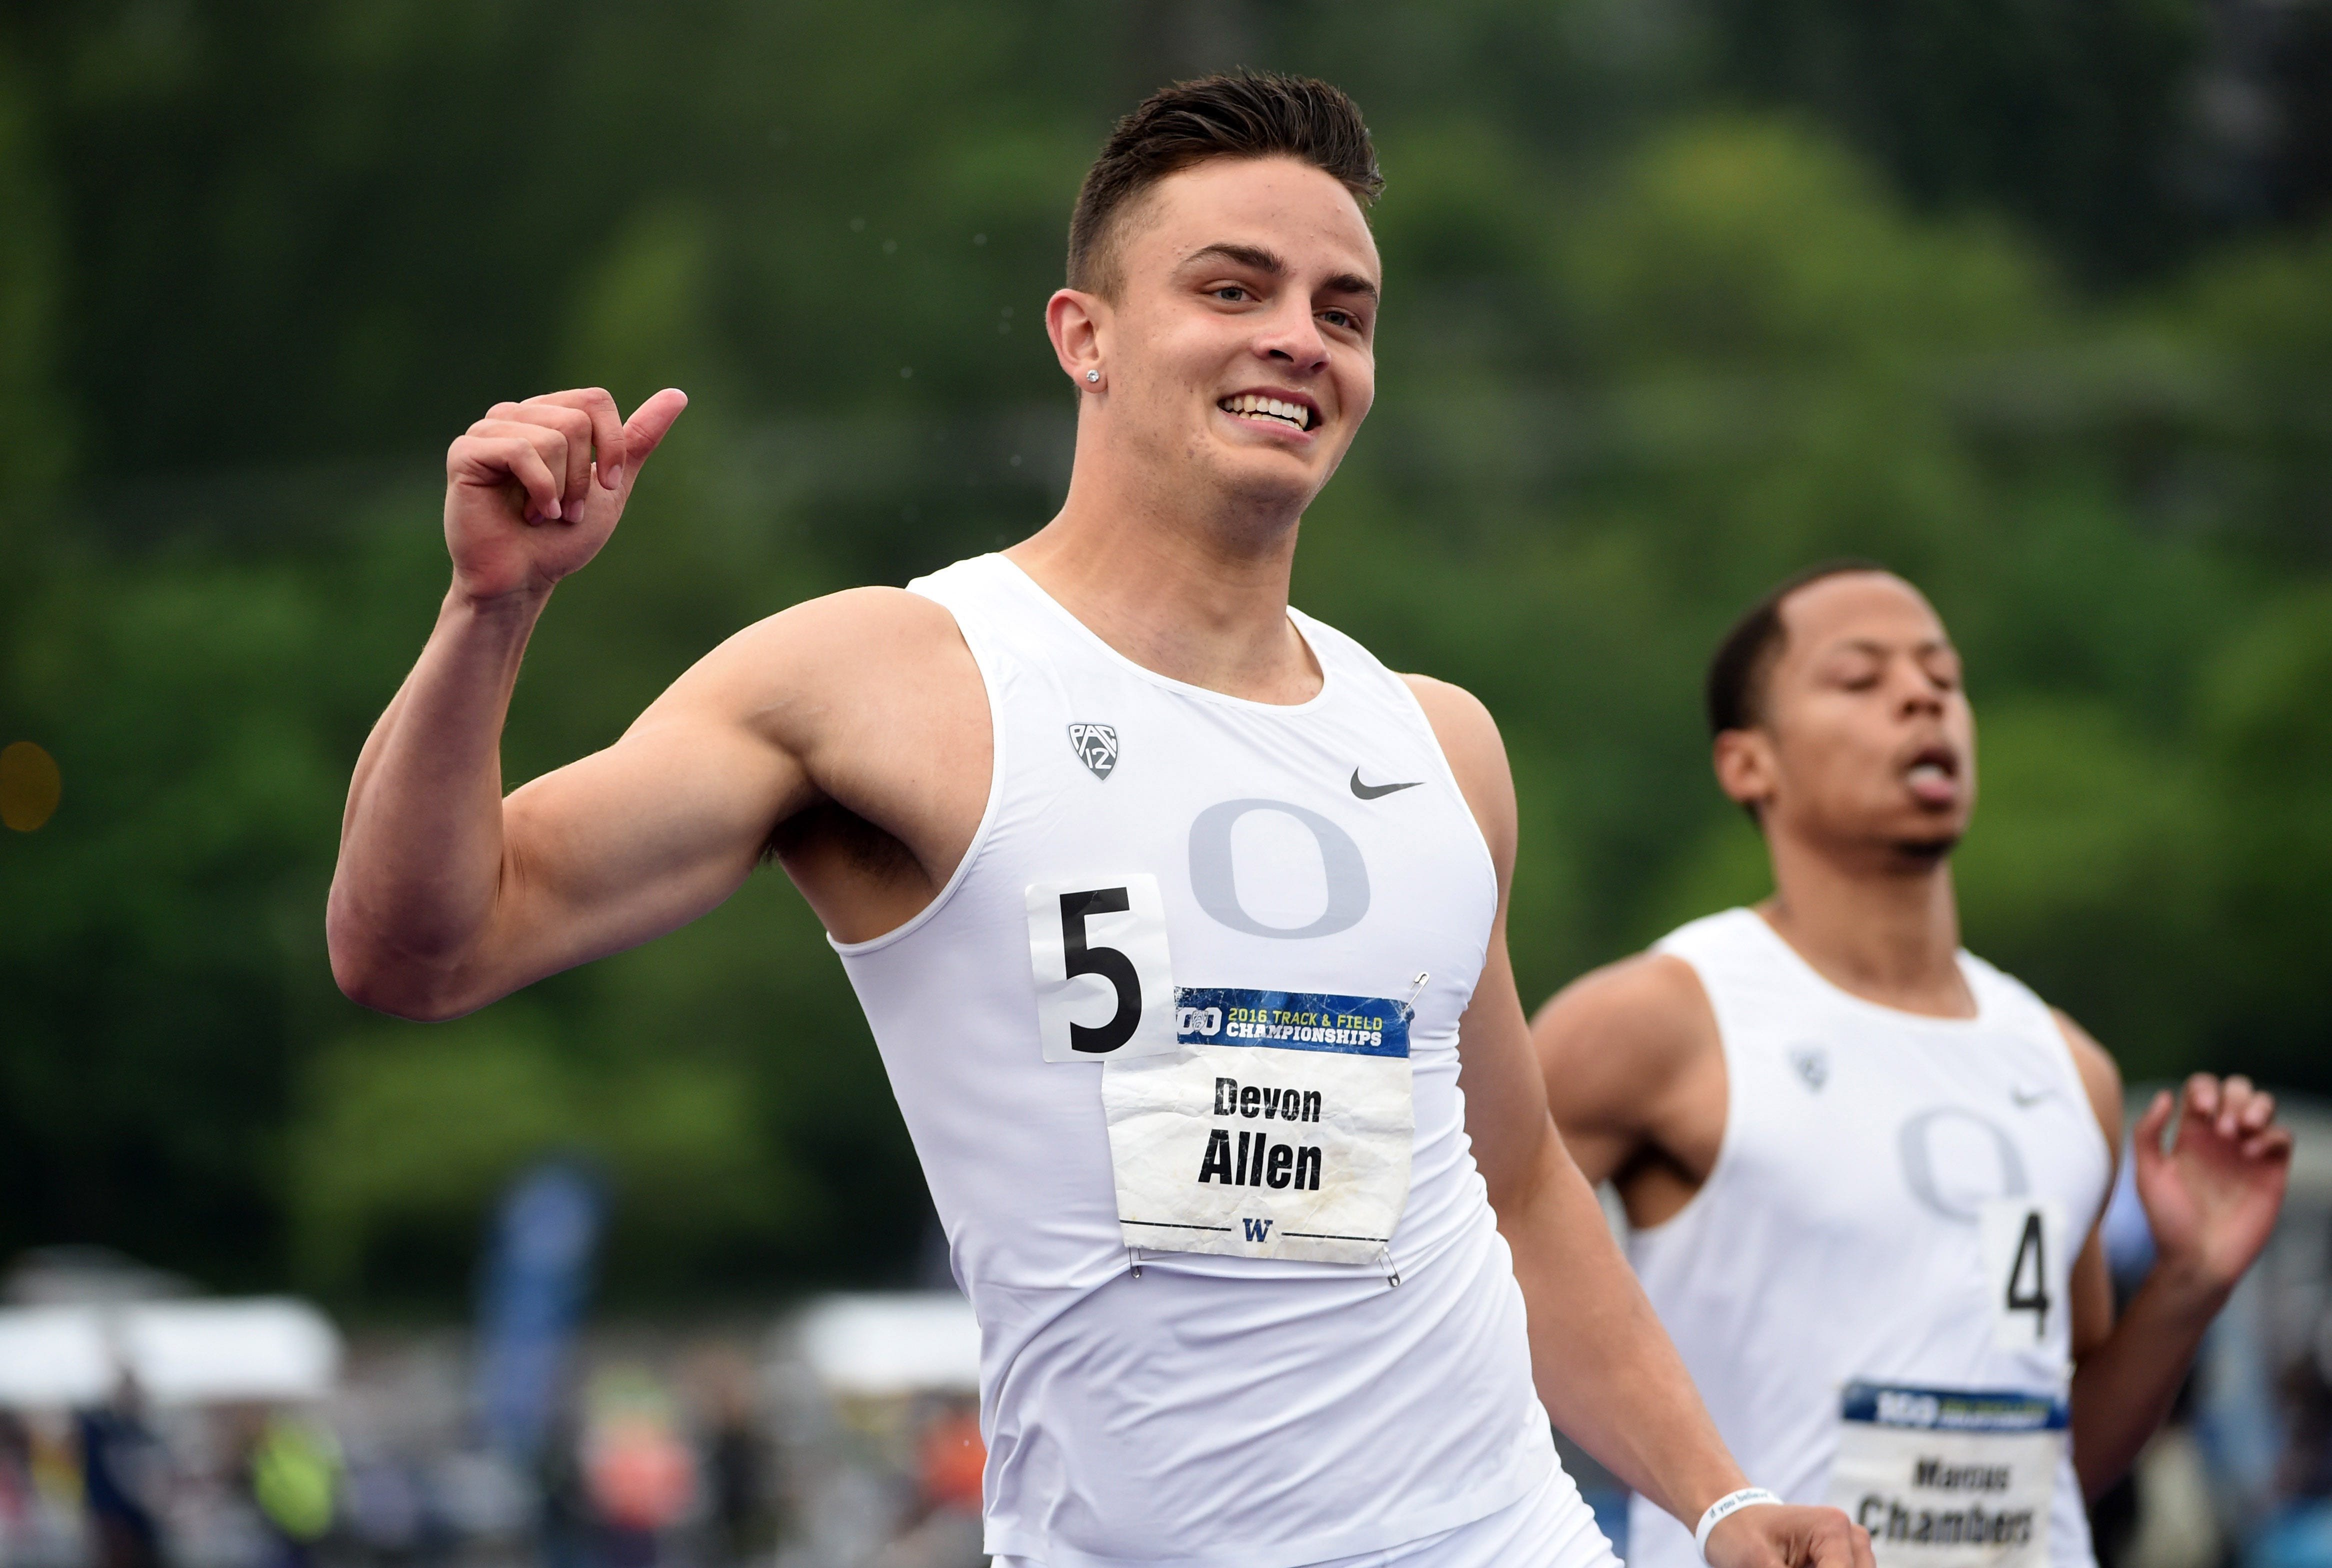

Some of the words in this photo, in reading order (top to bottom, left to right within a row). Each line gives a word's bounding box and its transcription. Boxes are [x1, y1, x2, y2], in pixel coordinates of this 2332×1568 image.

[1069, 724, 1118, 759] PAC
[1085, 747, 1112, 769] 12
[1188, 798, 1370, 939] O
[1060, 886, 1142, 1054] 5
[1226, 1022, 1382, 1047] CHAMPIONSHIPS
[1228, 1007, 1268, 1024] 2016
[1272, 1010, 1318, 1026] TRACK
[1322, 1014, 1332, 1027] &
[1337, 1014, 1383, 1031] FIELD
[1214, 1076, 1322, 1124] Devon
[1198, 1129, 1322, 1191] Allen
[1242, 1218, 1274, 1242] W
[2006, 1210, 2051, 1342] 4
[1857, 1492, 2034, 1546] Chambers
